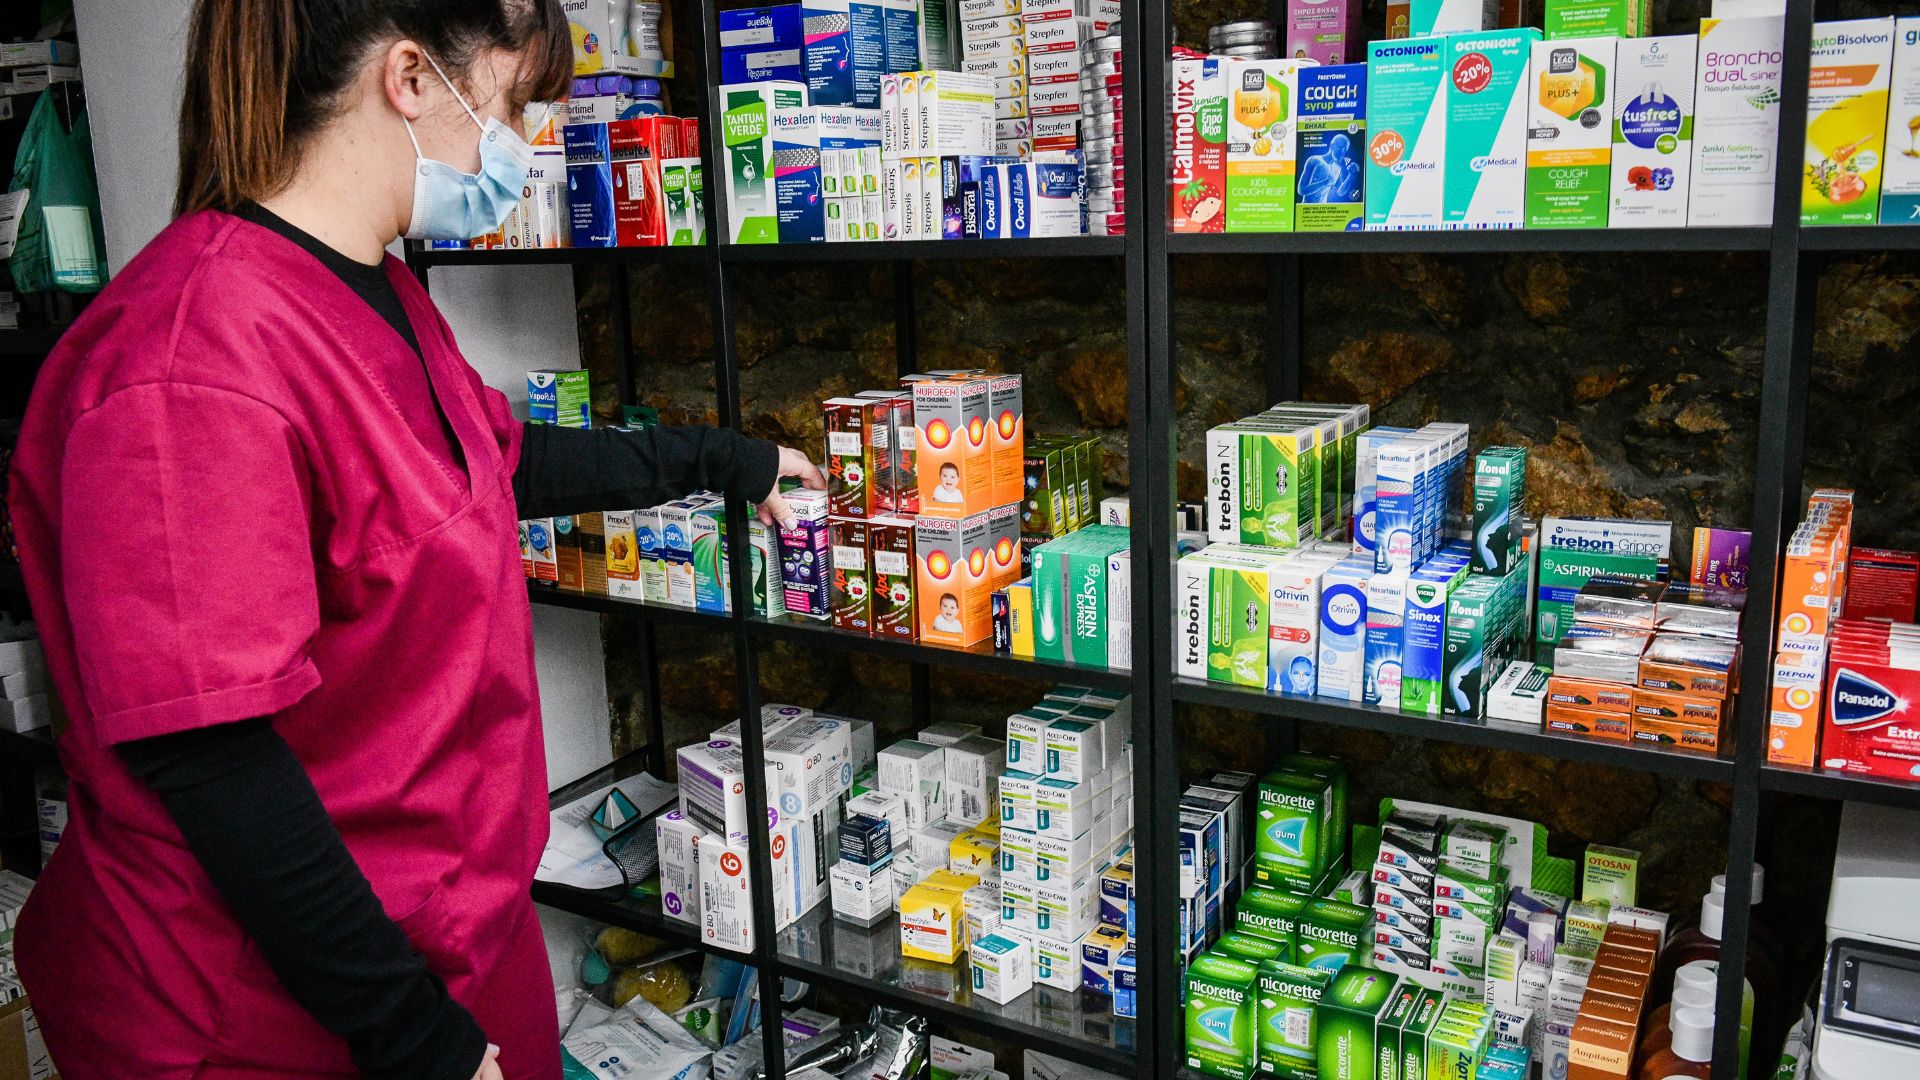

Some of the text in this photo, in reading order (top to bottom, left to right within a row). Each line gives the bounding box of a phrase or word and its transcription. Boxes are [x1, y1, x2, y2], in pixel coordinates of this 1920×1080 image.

[967, 21, 999, 32] Strepsils
[1030, 29, 1064, 39] Strepfen
[968, 41, 1001, 52] Strepsils
[1503, 48, 1519, 56] syrup
[1705, 50, 1782, 67] Broncho
[967, 61, 999, 72] Strepsils
[1033, 60, 1068, 71] Strepfen
[1456, 60, 1491, 84] -20%
[747, 68, 773, 80] Regaine
[1704, 68, 1777, 83] dual sine
[1034, 91, 1068, 101] Strepfen
[1304, 85, 1357, 101] COUGH
[1304, 101, 1334, 112] syrup
[725, 112, 765, 126] TANTUM
[774, 113, 816, 127] Hexalen
[1623, 109, 1678, 122] tusfree
[729, 123, 762, 137] VERDE
[902, 108, 910, 151] Strepsils
[920, 106, 928, 150] Strepsils
[1037, 122, 1071, 133] Strepfen
[1172, 79, 1195, 185] Calmovix
[1372, 138, 1403, 160] 30%
[1406, 161, 1435, 170] Medical
[1487, 158, 1517, 166] Medical
[663, 173, 685, 181] TANTUM
[1549, 169, 1588, 179] COUGH
[889, 168, 897, 210] Strepsils
[1251, 178, 1268, 187] KIDS
[1555, 179, 1581, 189] RELIEF
[1231, 186, 1287, 197] COUGH RELIEF
[924, 191, 932, 234] Strepsils
[965, 190, 976, 235] Bisoral
[962, 383, 987, 397] NUROFEN
[991, 378, 1020, 391] NUROFEN
[528, 391, 556, 402] VapoRub
[915, 387, 957, 397] NUROFEN
[1477, 459, 1510, 475] Ronal
[1218, 462, 1231, 532] trebon
[662, 512, 687, 522] PHYSIOMER
[988, 506, 1018, 520] NUROFEN
[917, 518, 957, 531] NUROFEN
[962, 515, 988, 529] NUROFEN
[1553, 564, 1606, 578] ASPIRIN
[1710, 559, 1720, 573] mg
[1729, 570, 1740, 584] 24
[1274, 588, 1310, 602] Otrivin
[1417, 589, 1435, 597] VICKS
[1084, 575, 1098, 639] ASPIRIN
[1330, 604, 1357, 615] Otrivin
[1450, 599, 1484, 617] Ronal
[1076, 593, 1085, 638] EXPRESS
[1408, 608, 1441, 623] Sinex
[1186, 594, 1200, 666] trebon
[1783, 642, 1820, 652] DEPON
[1777, 670, 1816, 680] DEPON
[1690, 682, 1726, 694] Panadol
[1597, 696, 1630, 707] Panadol
[1839, 691, 1889, 708] Panadol
[1683, 709, 1718, 721] Panadol
[1009, 721, 1038, 733] ACCU-CHEK
[1594, 724, 1628, 736] Panadol
[1046, 731, 1077, 742] ACCU-CHEK
[1681, 735, 1715, 748] Panadol
[813, 753, 822, 765] BD
[1000, 780, 1030, 791] ACCU-CHEK
[1036, 788, 1067, 799] ACCU-CHEK
[1260, 788, 1315, 810] nicorette
[785, 793, 796, 811] 8
[1002, 832, 1032, 844] ACCU-CHEK
[1275, 829, 1296, 840] gum
[1037, 840, 1067, 853] ACCU-CHEK
[1418, 856, 1436, 864] HERB
[1588, 856, 1632, 872] OTOSAN
[1104, 879, 1122, 889] Contour
[1411, 874, 1429, 883] HERB
[1003, 880, 1033, 893] ACCU-CHEK
[1474, 886, 1493, 894] HERB
[1037, 889, 1068, 902] ACCU-CHEK
[1262, 892, 1301, 905] nicorette
[1414, 897, 1432, 905] HERB
[1325, 903, 1366, 917] nicorette
[1472, 907, 1491, 915] HERB
[1237, 910, 1295, 933] nicorette
[1409, 916, 1427, 924] HERB
[1567, 919, 1603, 932] OTOSAN
[1300, 922, 1358, 946] nicorette
[1567, 926, 1590, 936] SPRAY
[1039, 939, 1069, 952] ACCU-CHEK
[1239, 938, 1277, 951] nicorette
[1413, 936, 1430, 944] HERB
[972, 949, 998, 963] ACCU-CHEK
[1085, 945, 1103, 955] Contour
[1213, 959, 1253, 973] nicorette
[1406, 957, 1424, 967] HERB
[1189, 979, 1244, 1003] nicorette
[1260, 976, 1322, 1001] nicorette
[1441, 981, 1475, 994] HERB
[1204, 1018, 1227, 1030] gum
[1572, 1046, 1621, 1066] Ampitasol
